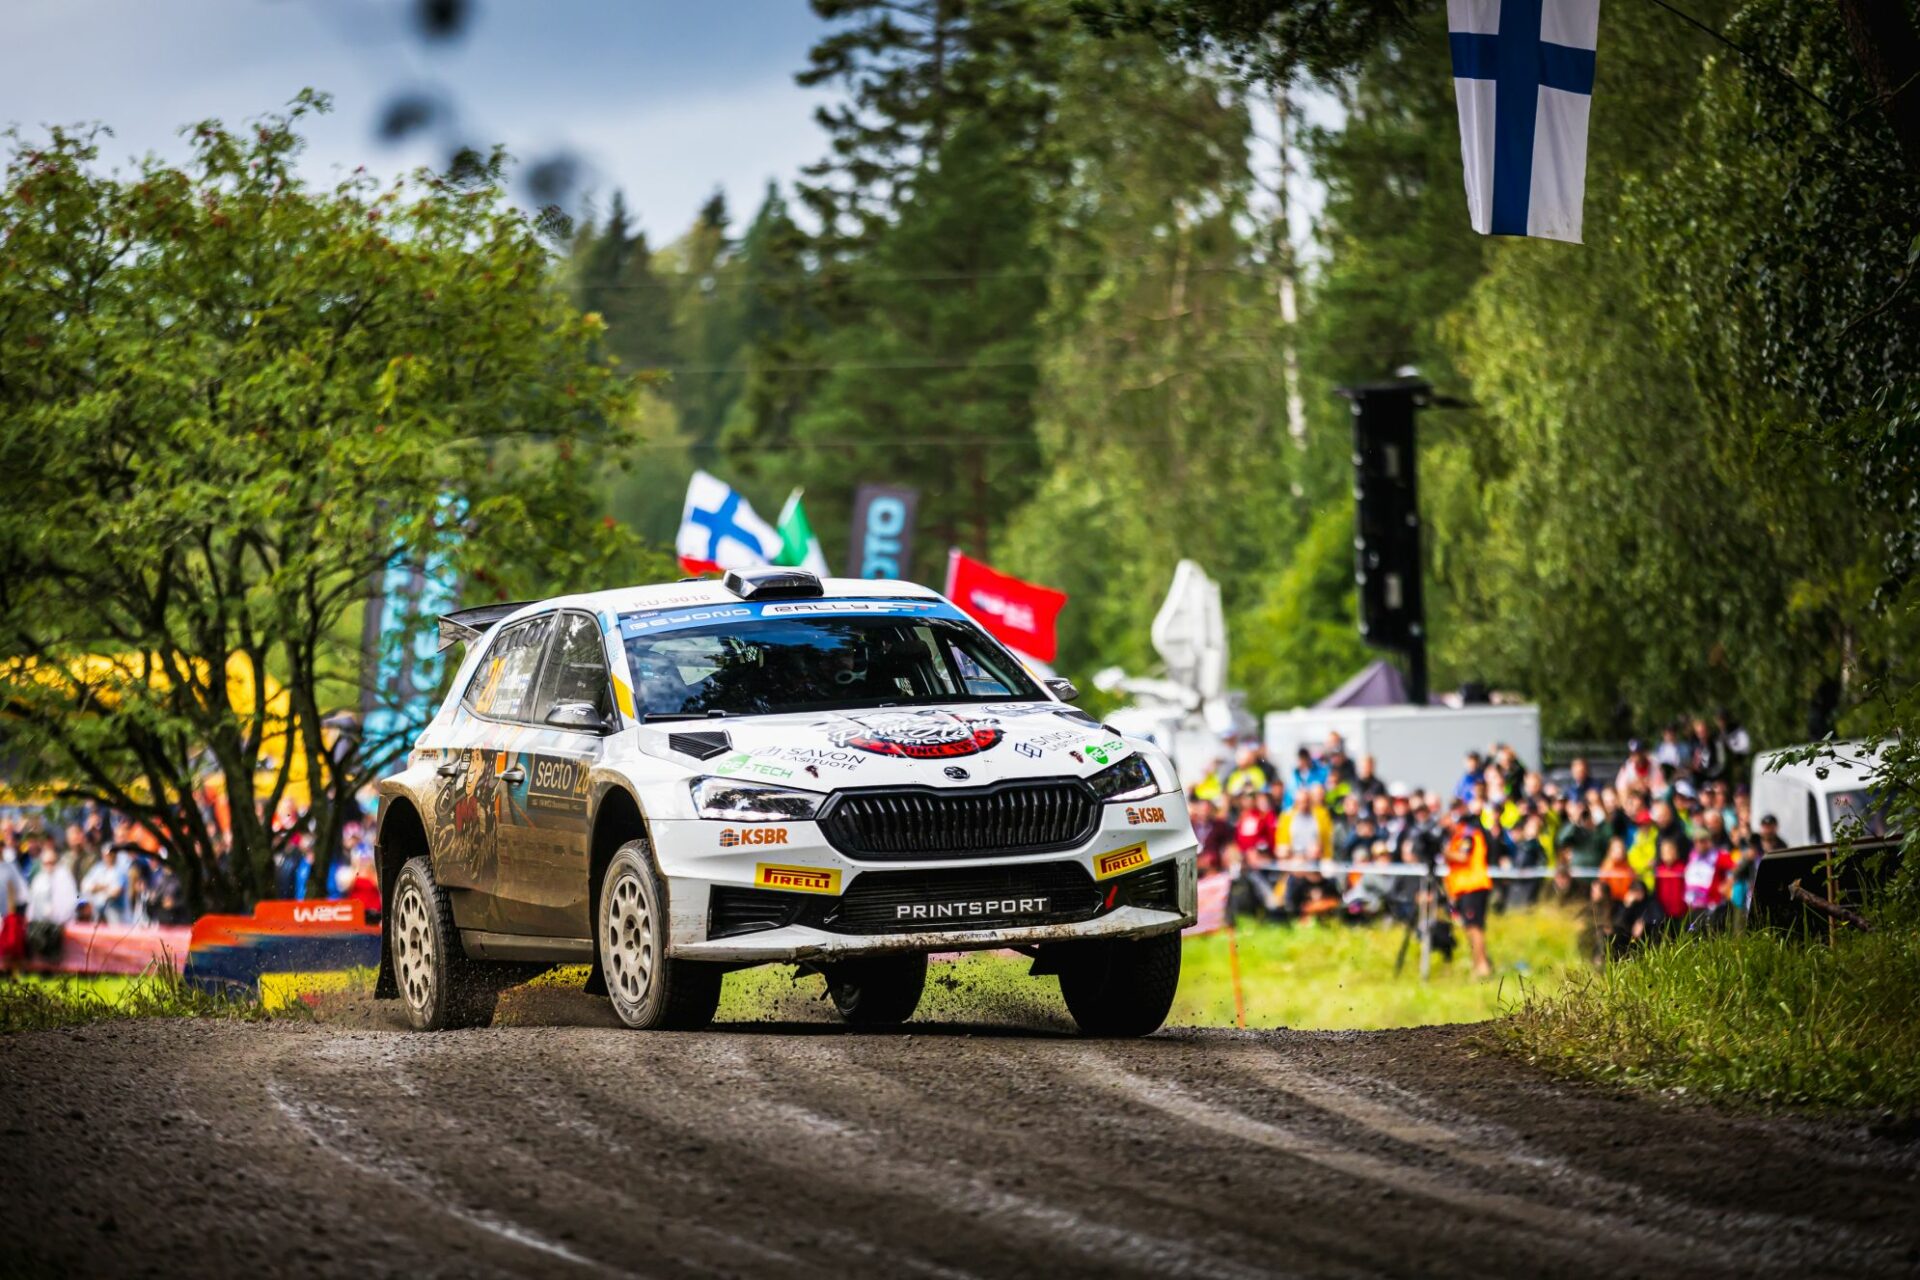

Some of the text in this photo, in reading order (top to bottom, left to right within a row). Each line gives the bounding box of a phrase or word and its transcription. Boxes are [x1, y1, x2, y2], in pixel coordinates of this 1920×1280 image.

[628, 608, 751, 631] BEYOND
[773, 603, 869, 613] RALLY
[789, 746, 867, 765] SAVON
[535, 760, 573, 791] secto
[718, 760, 795, 779] RE-TECH
[1138, 807, 1167, 823] KSBR
[741, 828, 789, 845] KSBR
[1100, 847, 1145, 874] PIRELLI
[763, 867, 832, 889] PIRELLI
[293, 904, 353, 923] WRC
[896, 897, 1049, 919] PRINTSPORT
